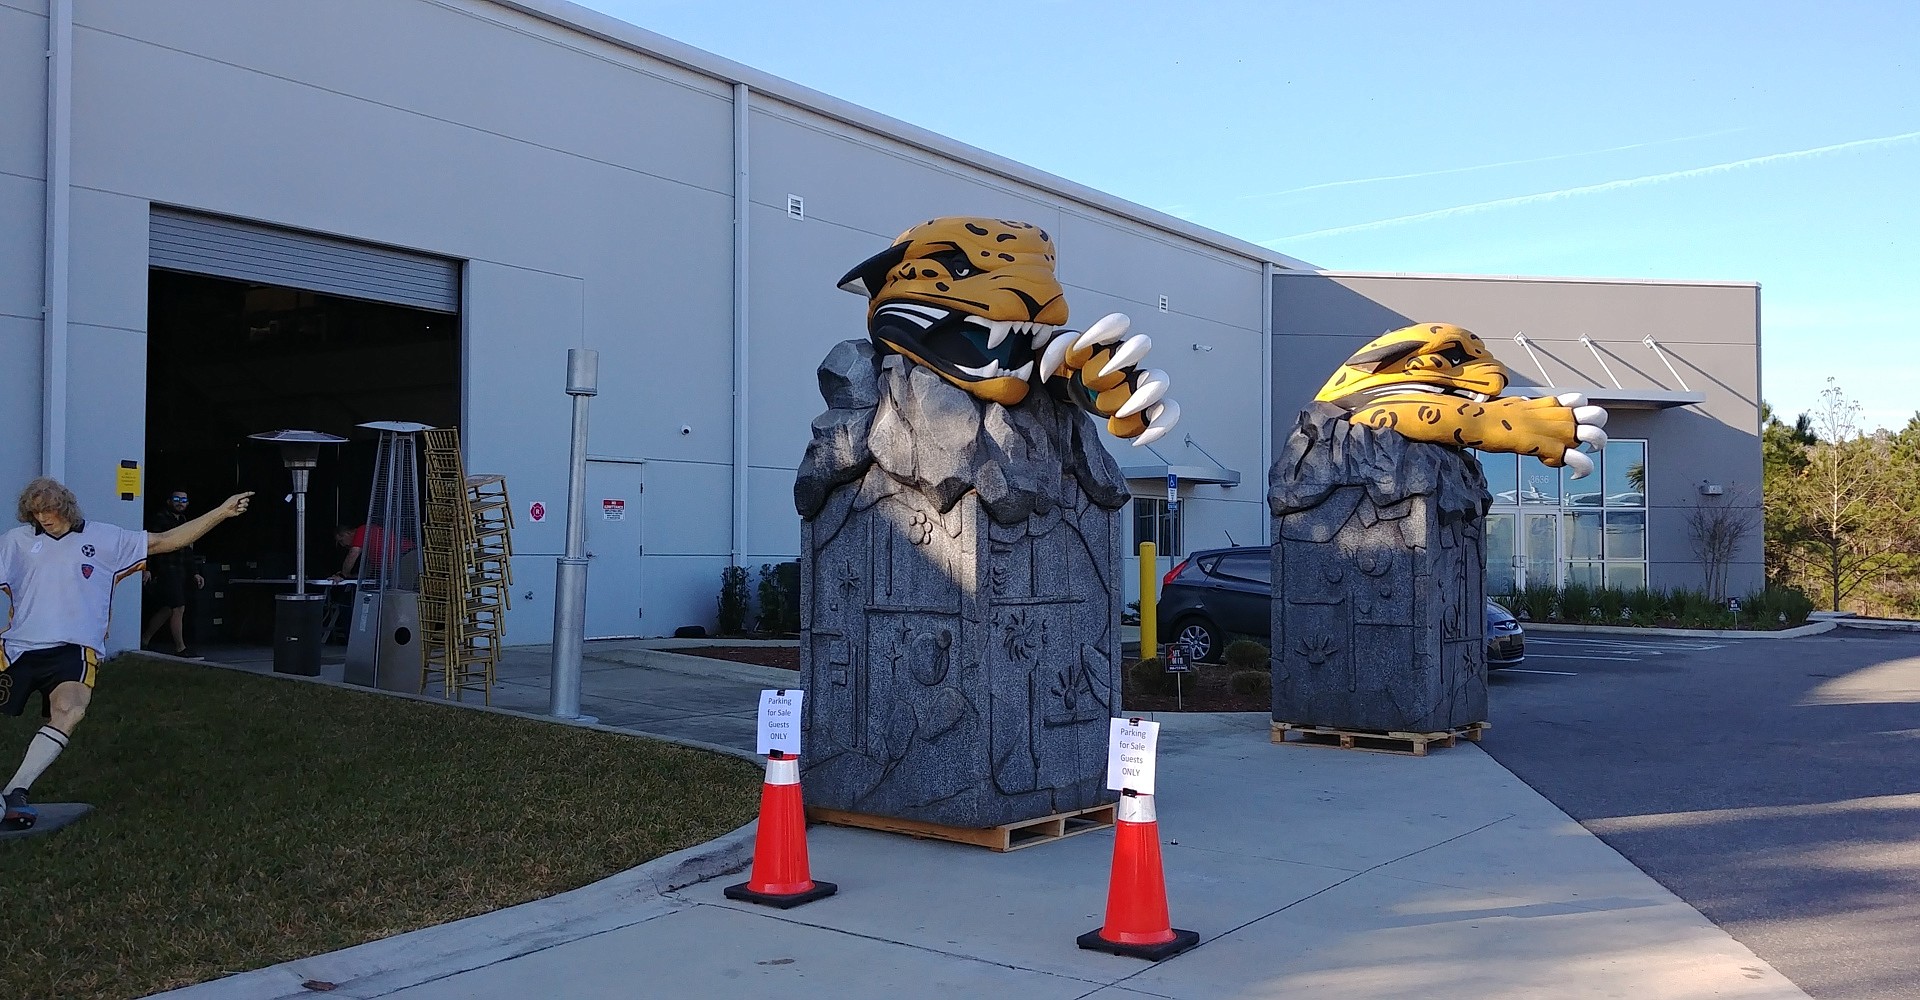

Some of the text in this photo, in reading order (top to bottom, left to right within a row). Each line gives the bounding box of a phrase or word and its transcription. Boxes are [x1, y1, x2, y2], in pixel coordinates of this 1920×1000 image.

[768, 697, 792, 706] Parking
[770, 732, 788, 740] ONLY
[1120, 728, 1147, 739] Parking
[1119, 741, 1146, 751] for Sale
[1120, 754, 1144, 764] Guests
[1122, 767, 1141, 776] ONLY
